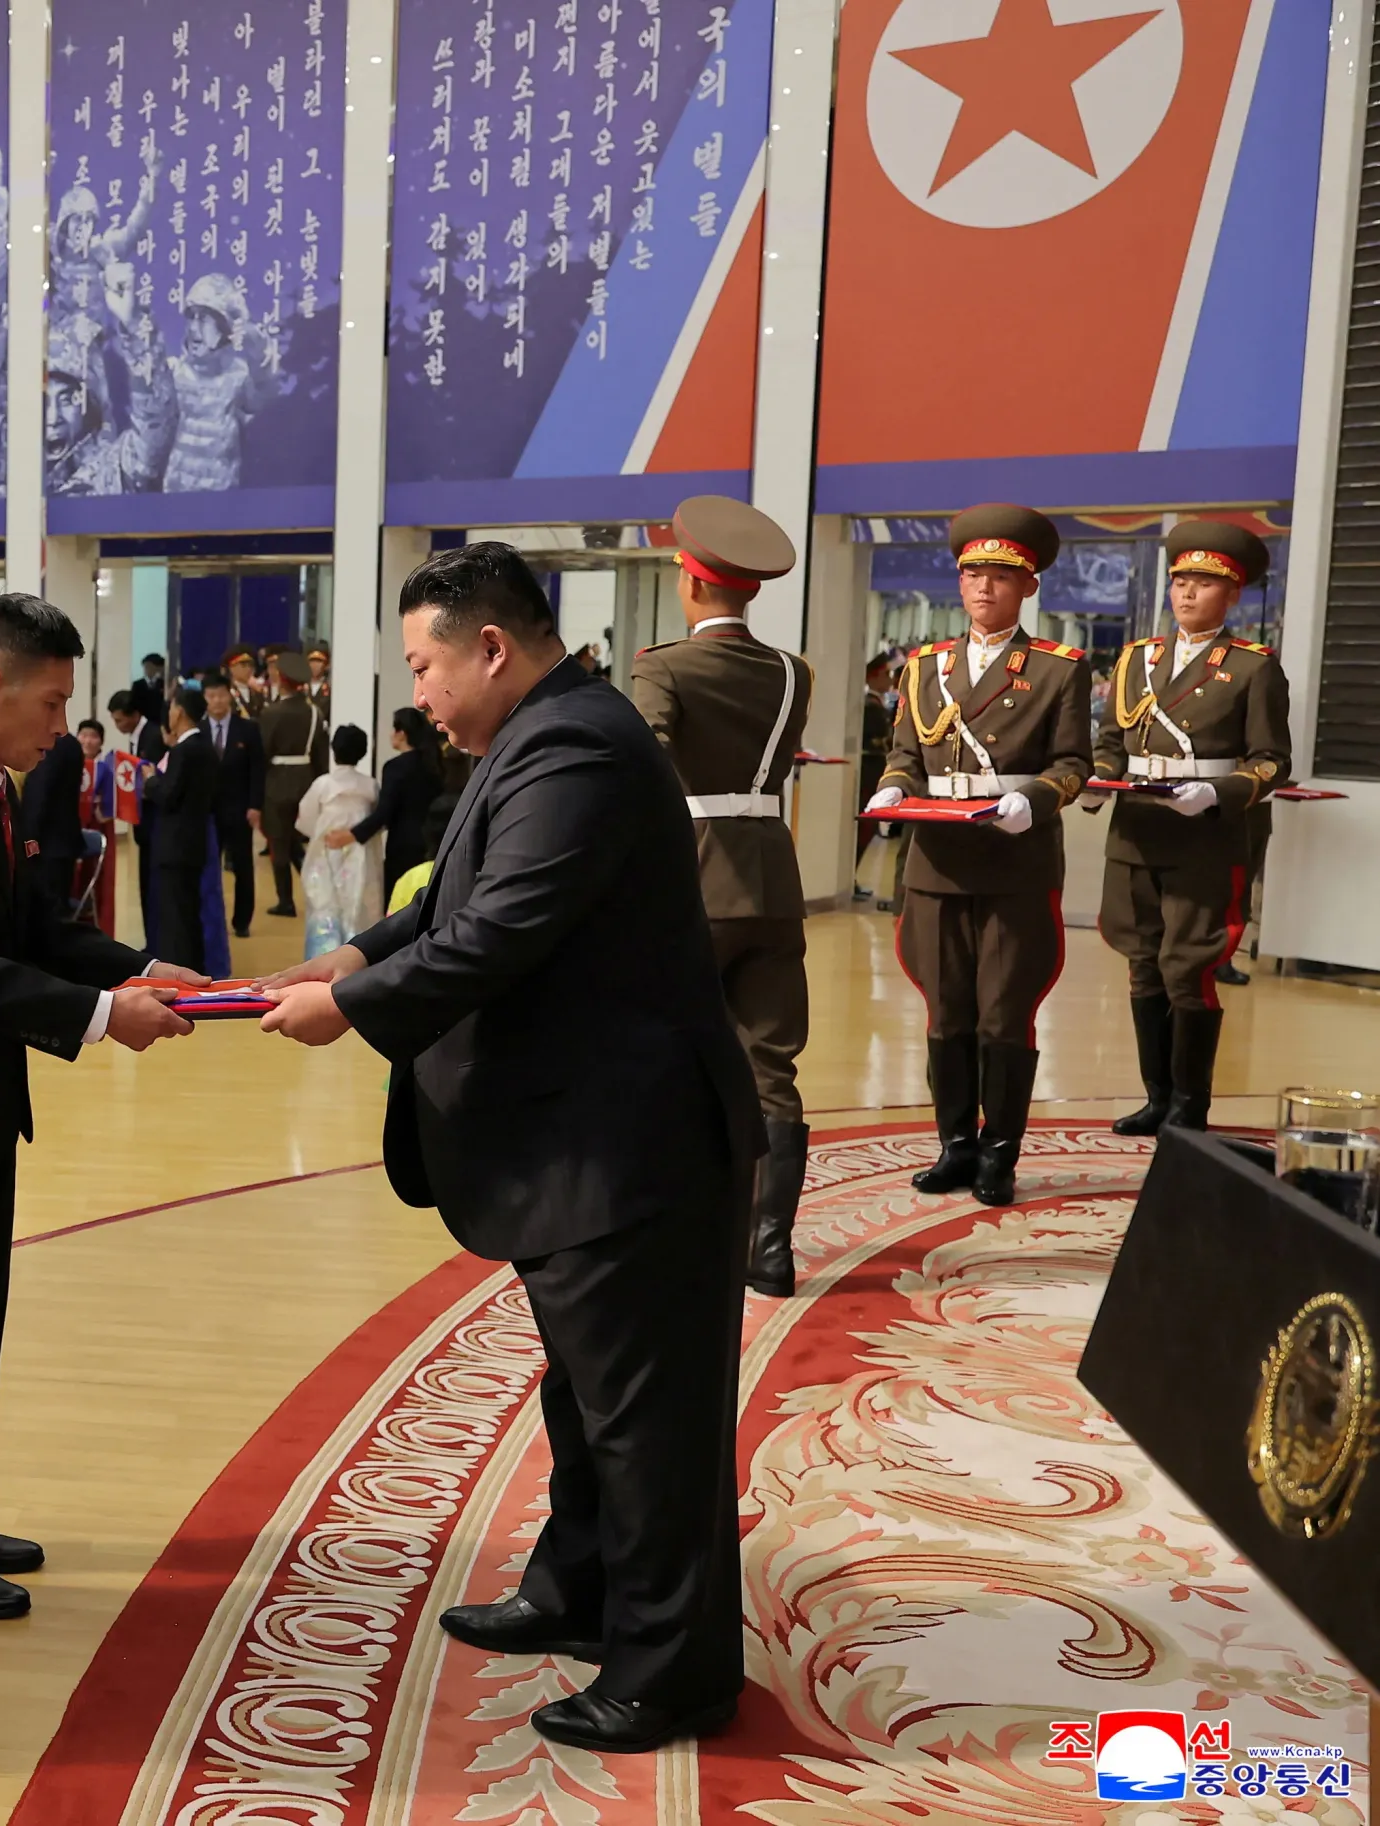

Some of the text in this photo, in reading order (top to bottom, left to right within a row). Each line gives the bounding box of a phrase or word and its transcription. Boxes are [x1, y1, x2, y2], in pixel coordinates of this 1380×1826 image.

[234, 12, 254, 50] 아
[590, 0, 622, 166] 아름다운
[74, 96, 91, 131] 내
[232, 84, 252, 206] 우리의
[267, 56, 286, 132] 별이
[167, 20, 190, 314] 빛나는 별들이여
[200, 76, 221, 259] 내 조국의
[300, 147, 321, 178] 그
[423, 37, 455, 386] 쓰러져도 감지 못한
[469, 116, 491, 197] 꿈이
[503, 19, 536, 378] 미소처럼 생각되네
[547, 110, 574, 275] 그대들의
[689, 131, 723, 237] 별들
[299, 208, 321, 319] 눈빛들
[465, 222, 487, 302] 있어
